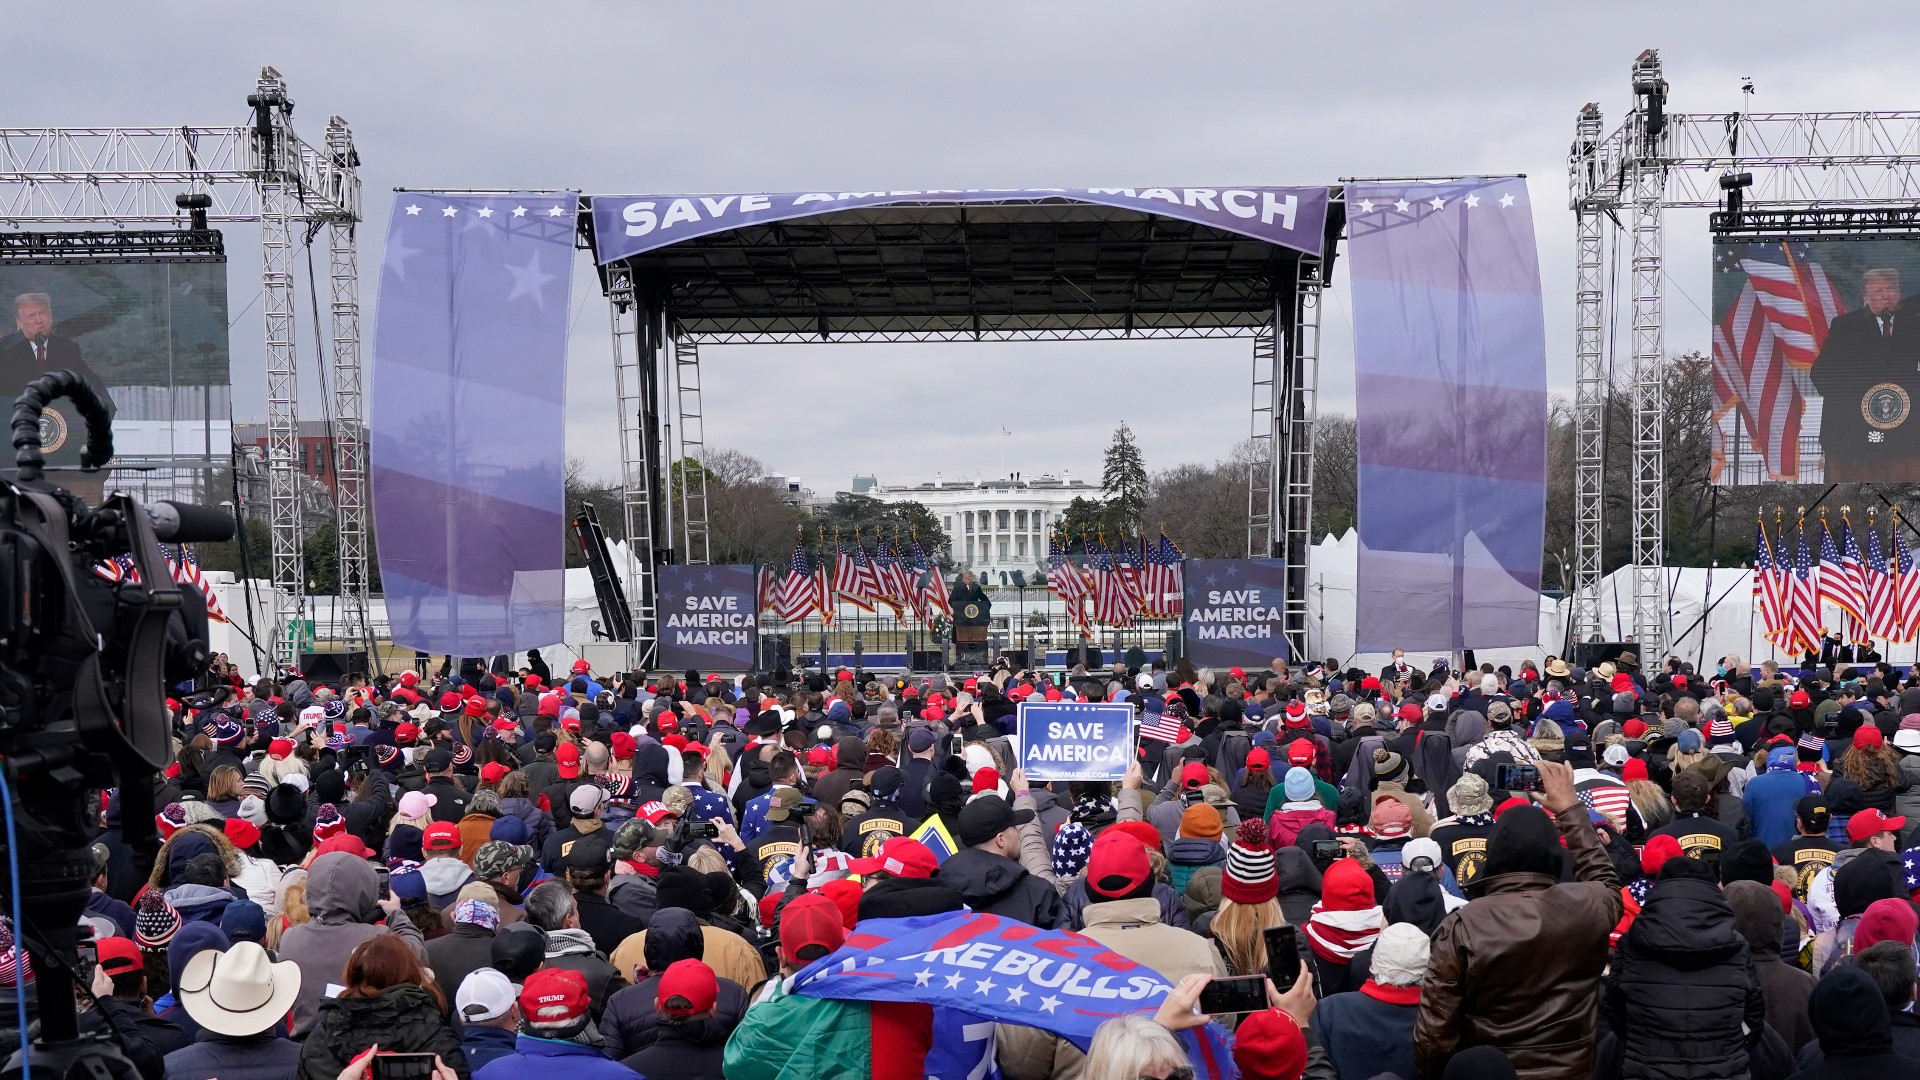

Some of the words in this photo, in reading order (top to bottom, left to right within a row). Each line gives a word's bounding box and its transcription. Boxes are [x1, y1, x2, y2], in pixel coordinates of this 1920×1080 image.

[622, 194, 772, 238] SAVE
[685, 596, 738, 611] SAVE
[1208, 590, 1261, 605] SAVE
[666, 613, 755, 628] AMERICA
[1189, 607, 1281, 622] AMERICA
[676, 631, 748, 645] MARCH
[1198, 624, 1271, 640] MARCH
[1047, 721, 1104, 740] SAVE
[1027, 744, 1125, 762] AMERICA
[991, 949, 1174, 1000] BULLS
[538, 994, 565, 1003] TRUMP
